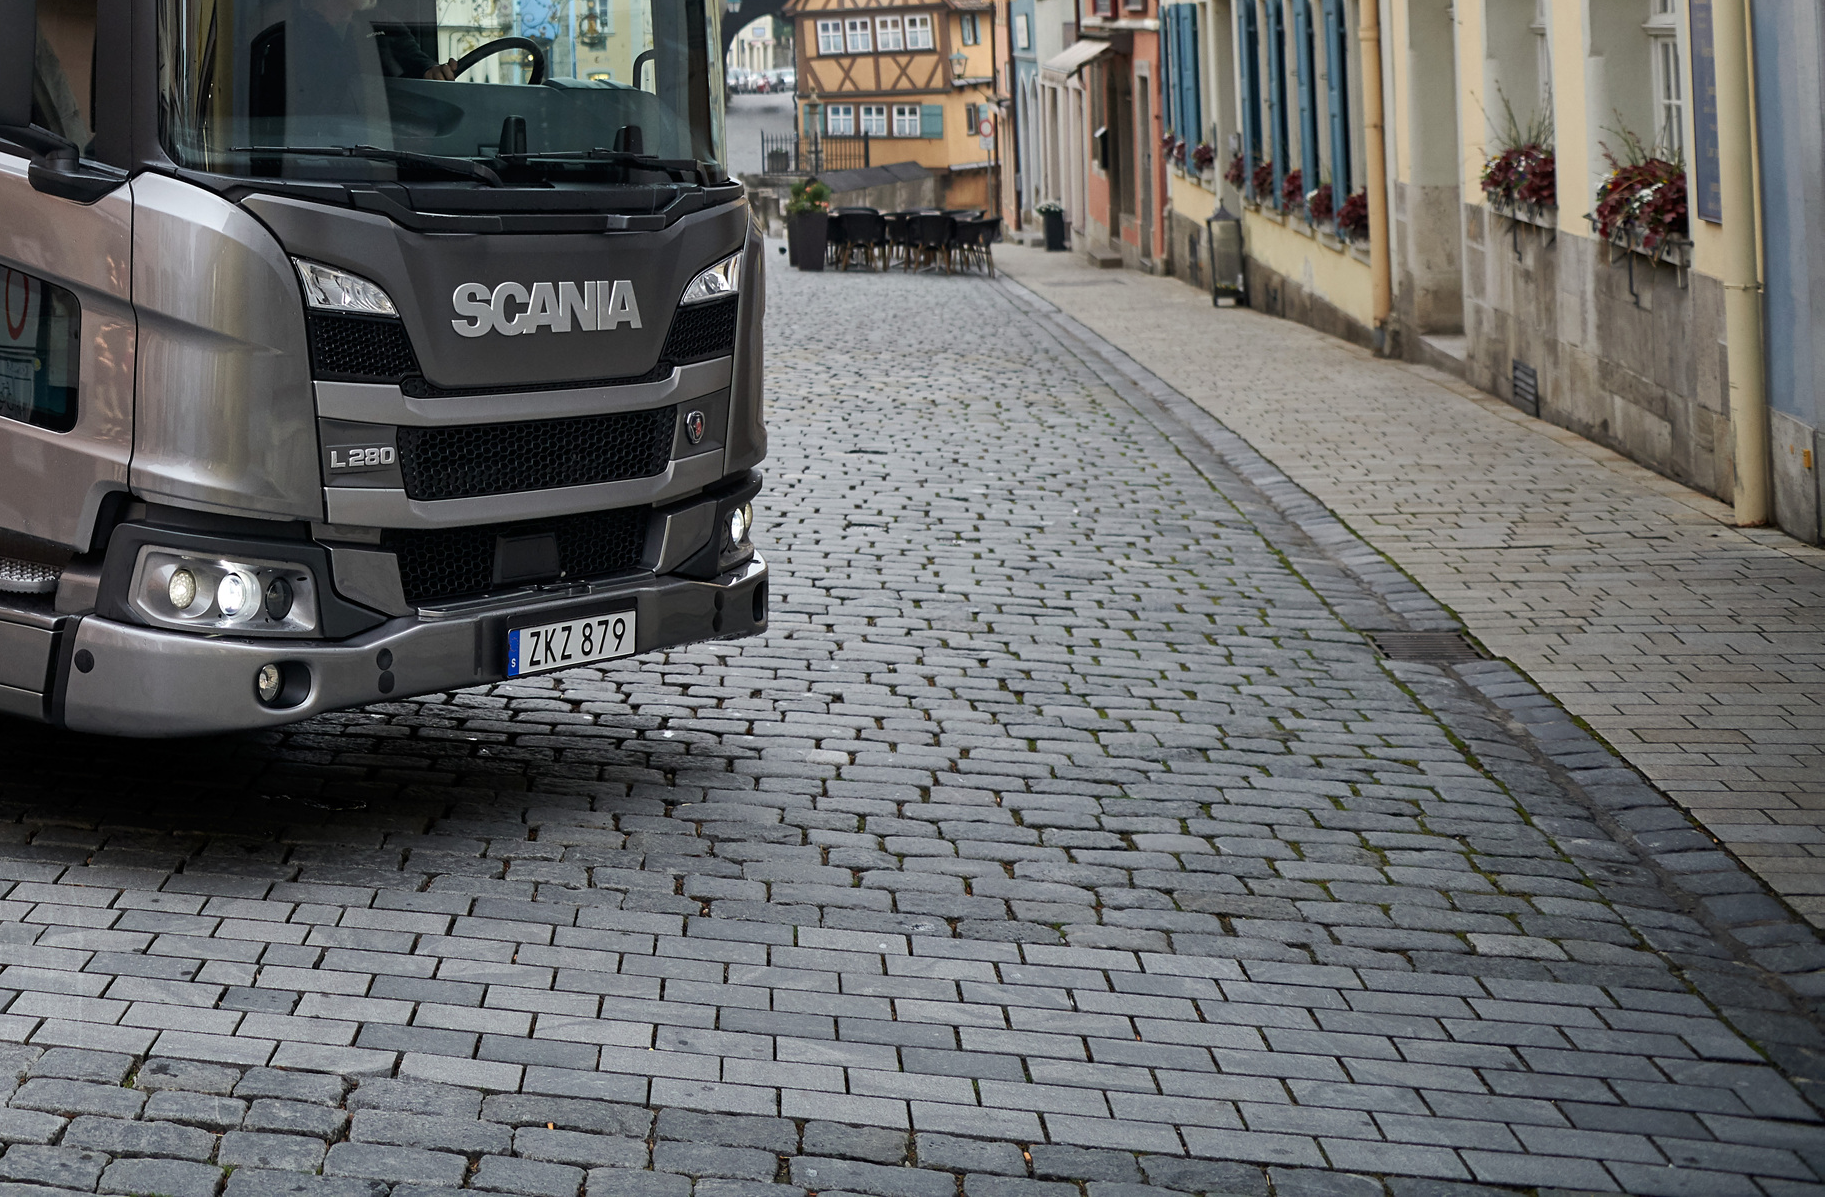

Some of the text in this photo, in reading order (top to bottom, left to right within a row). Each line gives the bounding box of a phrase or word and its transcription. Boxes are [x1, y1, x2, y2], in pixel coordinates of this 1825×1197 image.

[451, 280, 642, 338] SCANIA
[511, 658, 516, 668] S
[529, 618, 626, 667] ZKZ 879
